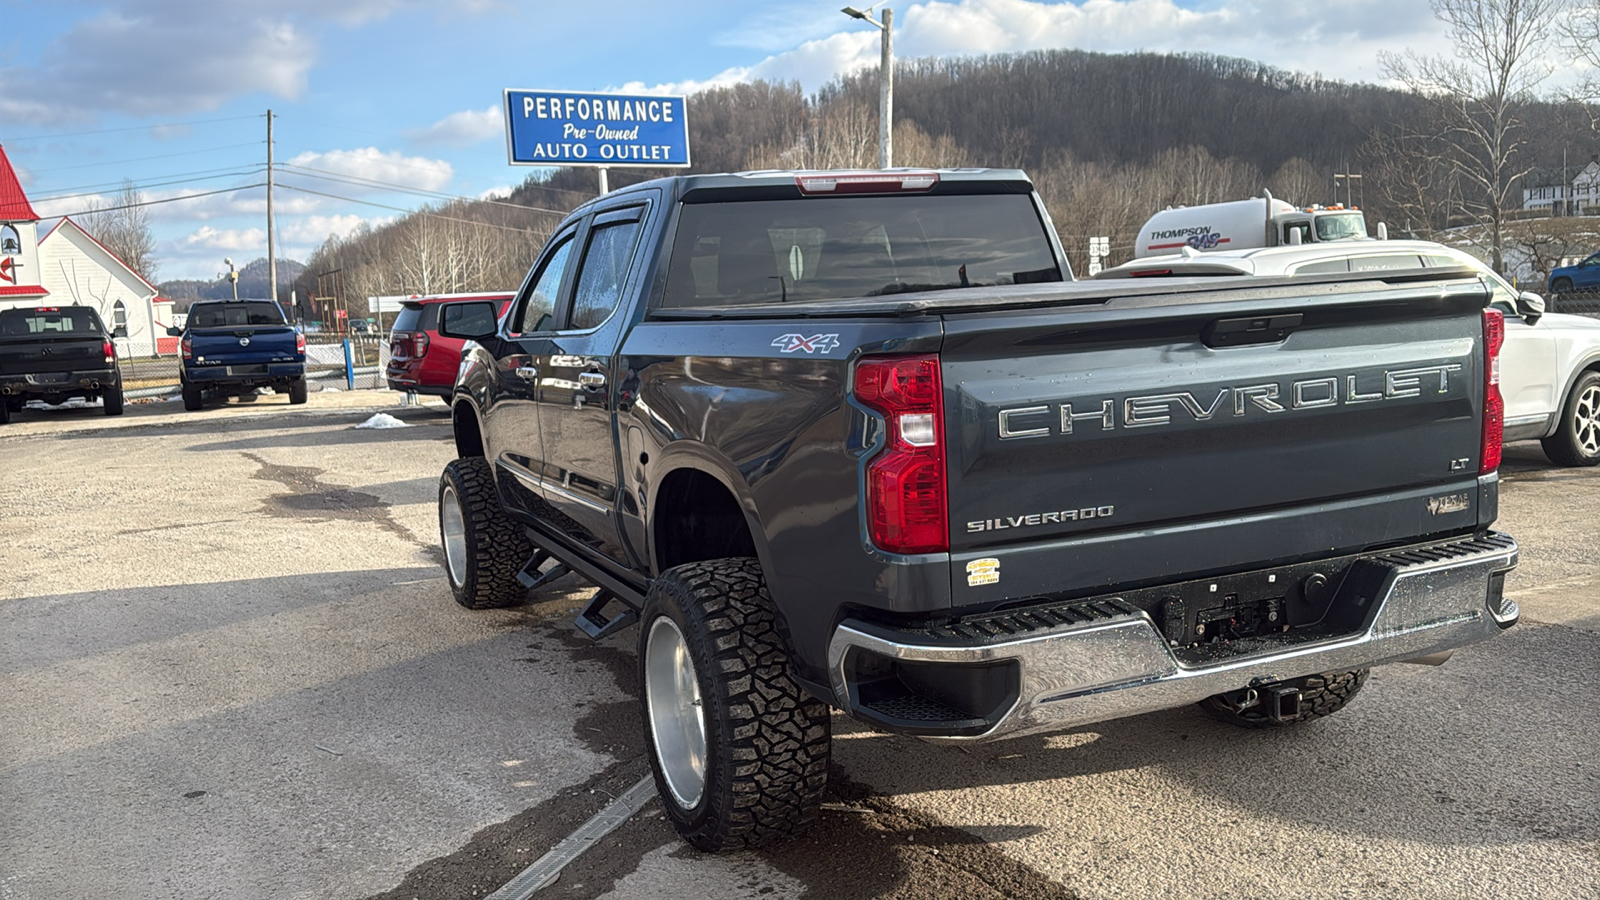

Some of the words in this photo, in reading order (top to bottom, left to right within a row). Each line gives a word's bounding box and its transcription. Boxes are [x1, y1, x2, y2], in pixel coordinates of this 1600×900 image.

[523, 96, 673, 123] PERFORMANCE
[563, 123, 639, 141] Pre-Owned
[533, 143, 588, 158] AUTO
[600, 144, 671, 160] OUTLET
[1151, 226, 1212, 240] THOMPSON
[998, 363, 1462, 440] CHEVROLET
[1451, 458, 1470, 470] LT
[967, 505, 1114, 533] SILVERADO
